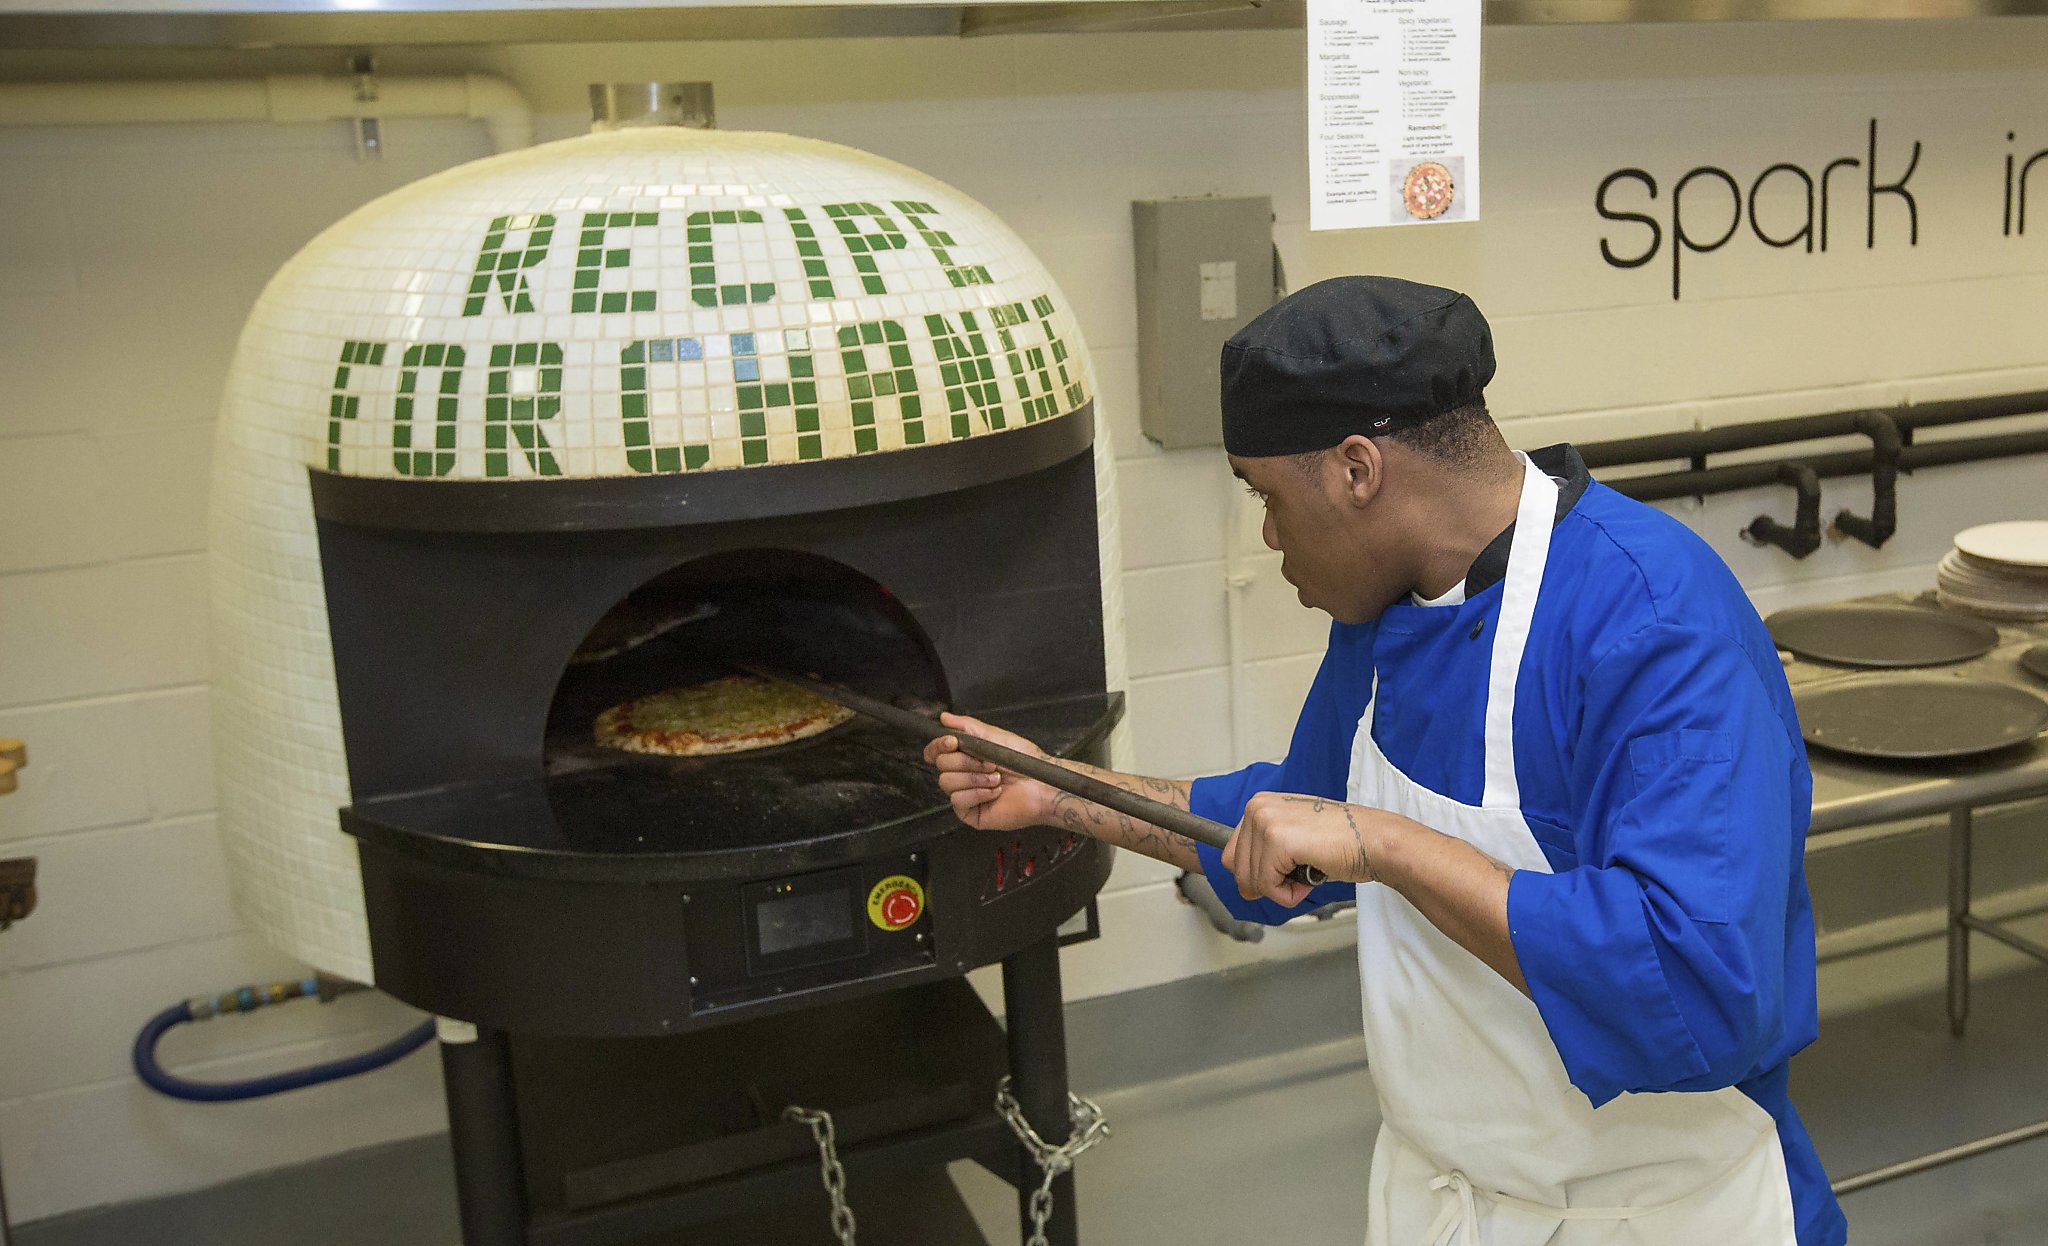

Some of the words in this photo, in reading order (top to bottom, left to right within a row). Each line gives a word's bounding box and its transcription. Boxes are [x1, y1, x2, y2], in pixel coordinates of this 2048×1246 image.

[461, 200, 994, 317] RECIPE
[1595, 117, 1922, 301] spark
[327, 340, 563, 478] FOR
[620, 294, 1085, 475] CHANGE
